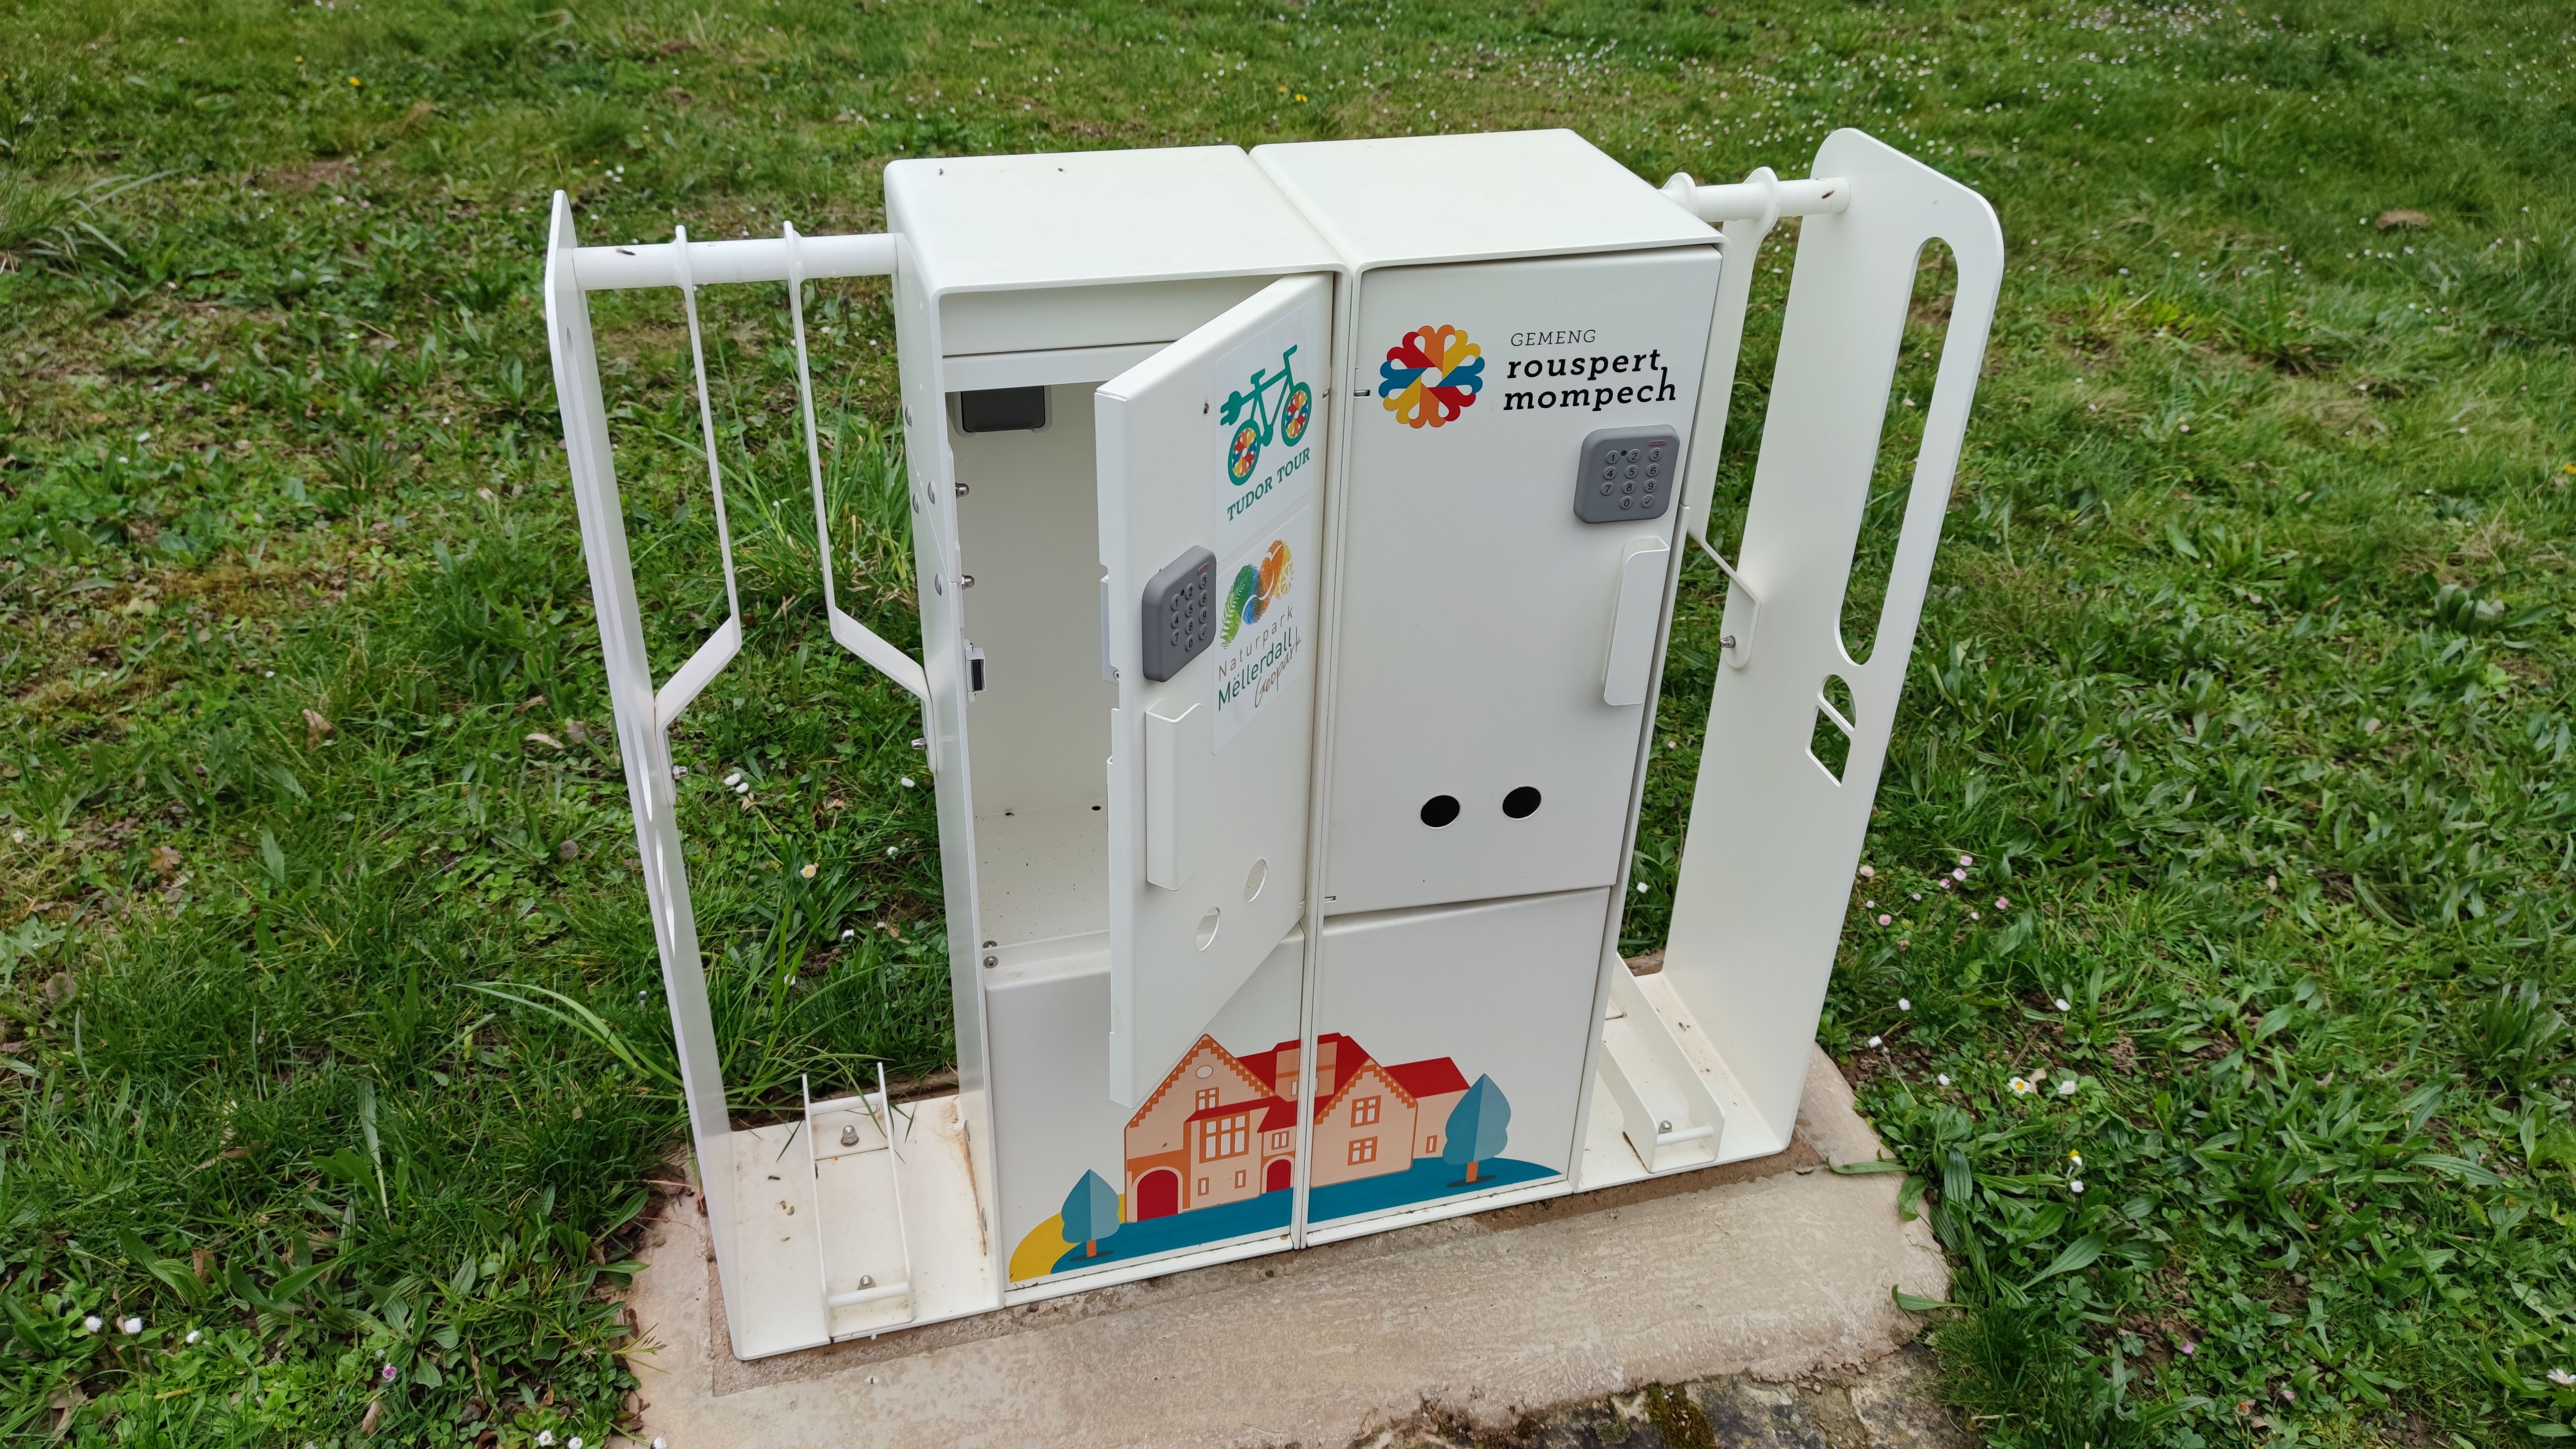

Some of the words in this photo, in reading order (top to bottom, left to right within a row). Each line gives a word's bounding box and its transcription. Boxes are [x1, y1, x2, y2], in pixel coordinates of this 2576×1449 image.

[1511, 329, 1596, 347] GEMENG
[1507, 349, 1661, 381] rouspert
[1503, 366, 1676, 411] mompech
[1652, 451, 1659, 459] 3
[1227, 476, 1273, 521] TUDOR
[1277, 447, 1310, 483] TOUR
[1650, 466, 1656, 475] 6
[1626, 483, 1632, 491] 8
[1175, 598, 1178, 606] 1
[1189, 587, 1193, 597] 2
[1203, 576, 1207, 586] 3
[1174, 615, 1179, 624] 4
[1189, 604, 1193, 614] 5
[1202, 594, 1207, 603] 6
[1174, 633, 1179, 642] 7
[1189, 622, 1193, 631] 8
[1202, 611, 1207, 620] 9
[1188, 638, 1193, 648] 0
[1219, 606, 1292, 681] Naturpark
[1218, 627, 1292, 712] Mëllerdall
[1254, 626, 1302, 708] Geopark
